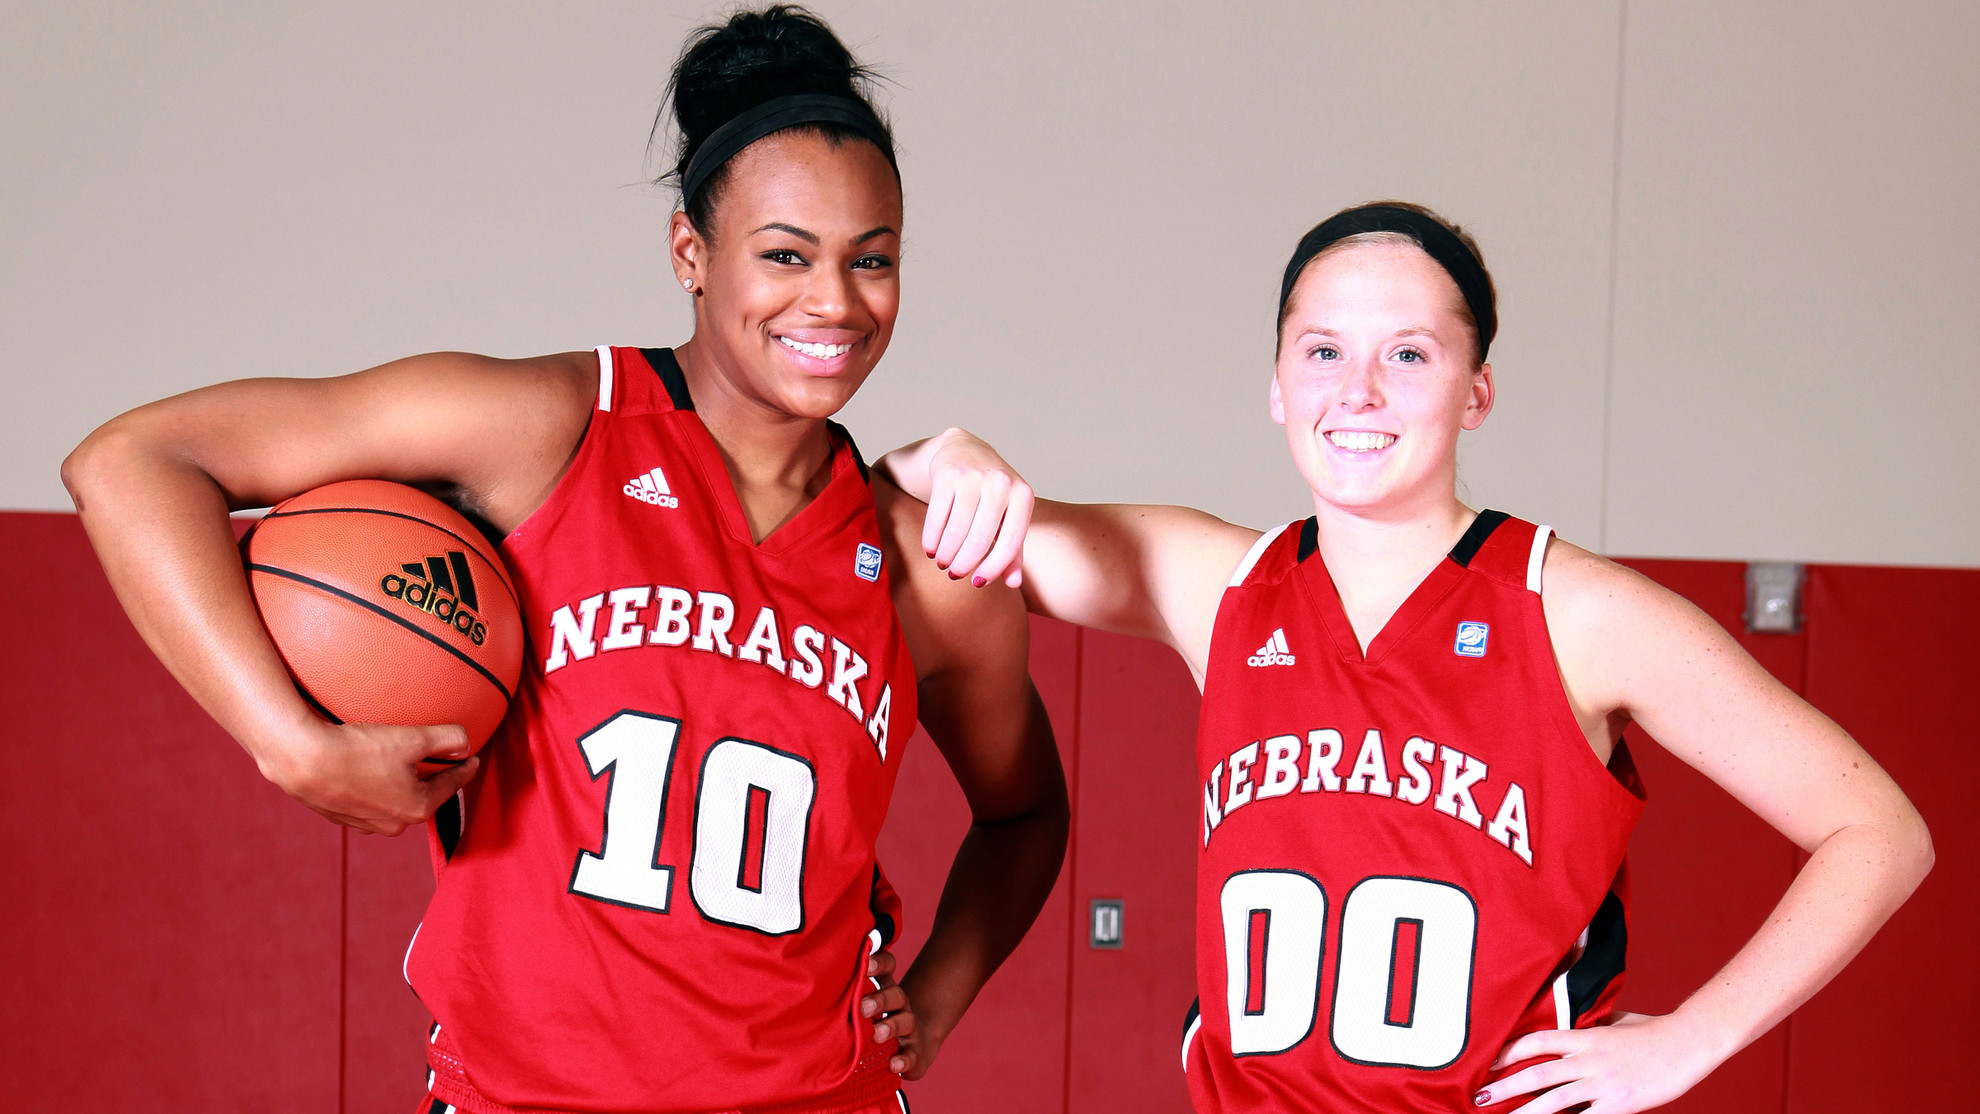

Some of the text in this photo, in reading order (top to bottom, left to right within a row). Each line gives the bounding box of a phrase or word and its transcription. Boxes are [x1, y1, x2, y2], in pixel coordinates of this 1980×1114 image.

[623, 484, 679, 509] adidas
[380, 574, 487, 647] adidas
[544, 585, 893, 764] NEBRASKA
[1247, 653, 1296, 667] adidas
[568, 708, 818, 935] 10
[1203, 729, 1534, 868] NEBRASKA
[1220, 868, 1478, 1071] 00
